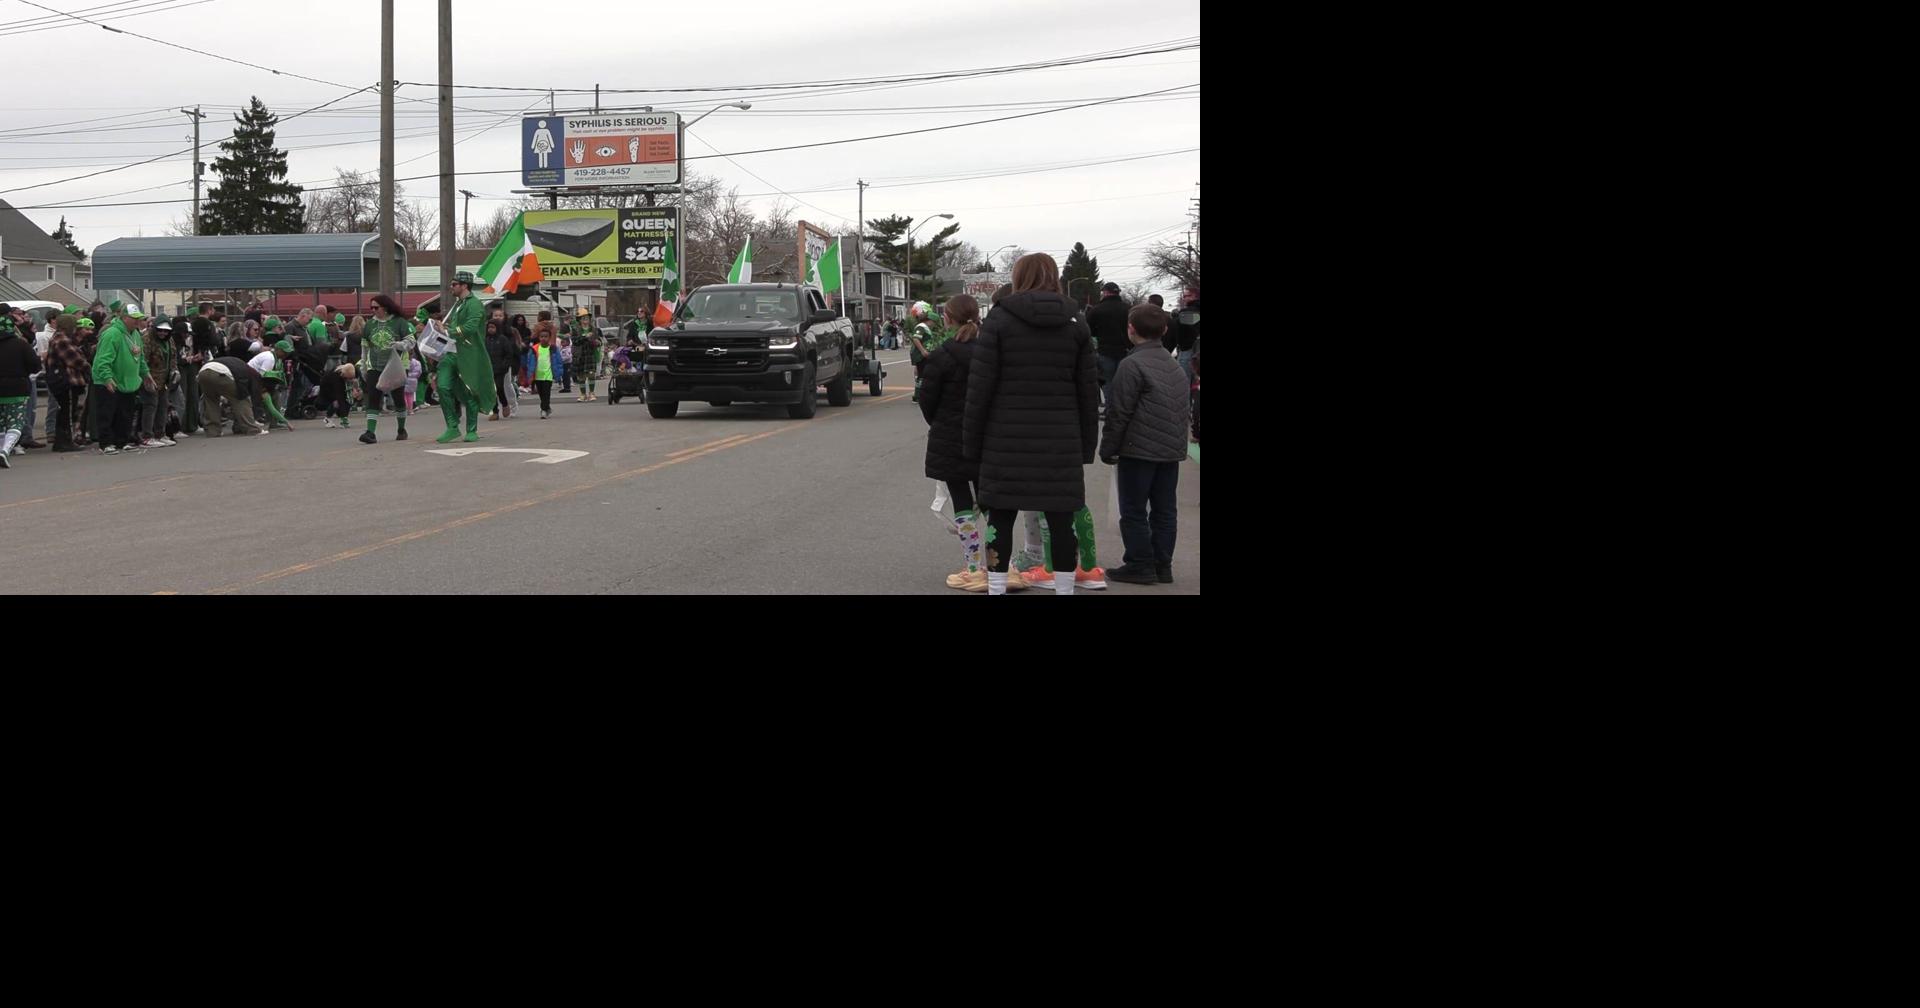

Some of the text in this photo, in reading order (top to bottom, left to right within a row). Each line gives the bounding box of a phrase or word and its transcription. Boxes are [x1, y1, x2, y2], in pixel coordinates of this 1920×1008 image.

[569, 117, 667, 128] SYPHILIS IS SERIOUS
[574, 168, 631, 176] 419-228-4457
[622, 218, 675, 230] QUEEN
[541, 266, 591, 276] EMAN'S
